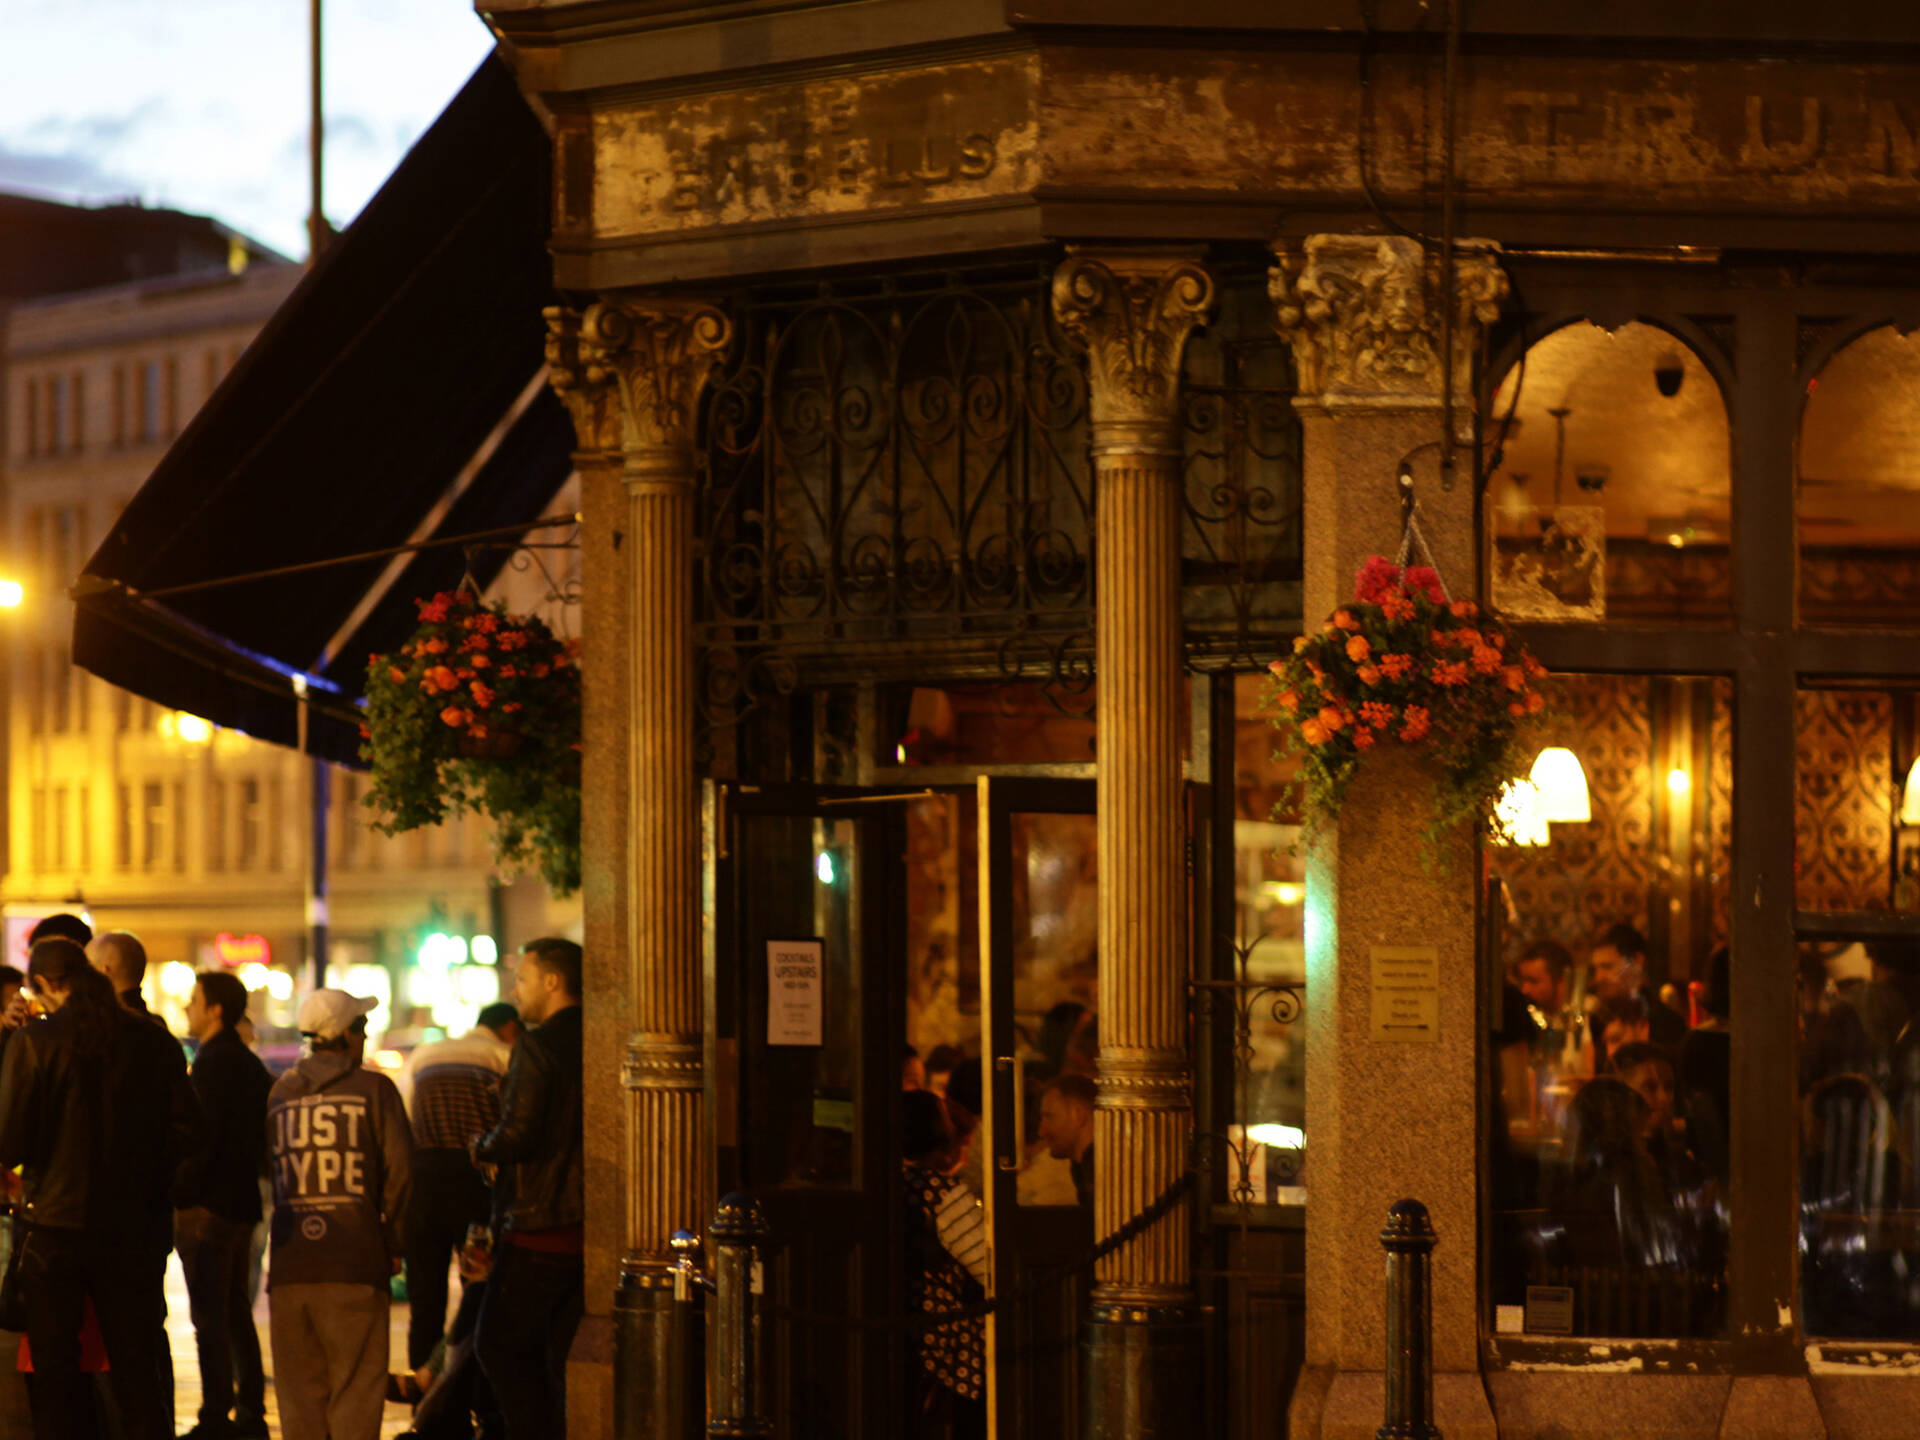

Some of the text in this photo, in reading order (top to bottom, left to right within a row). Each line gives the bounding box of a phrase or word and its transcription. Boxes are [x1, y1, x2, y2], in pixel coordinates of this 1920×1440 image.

[775, 965, 817, 979] UPSTAIRS
[272, 1104, 367, 1155] JUST
[272, 1149, 366, 1198] HYPE
